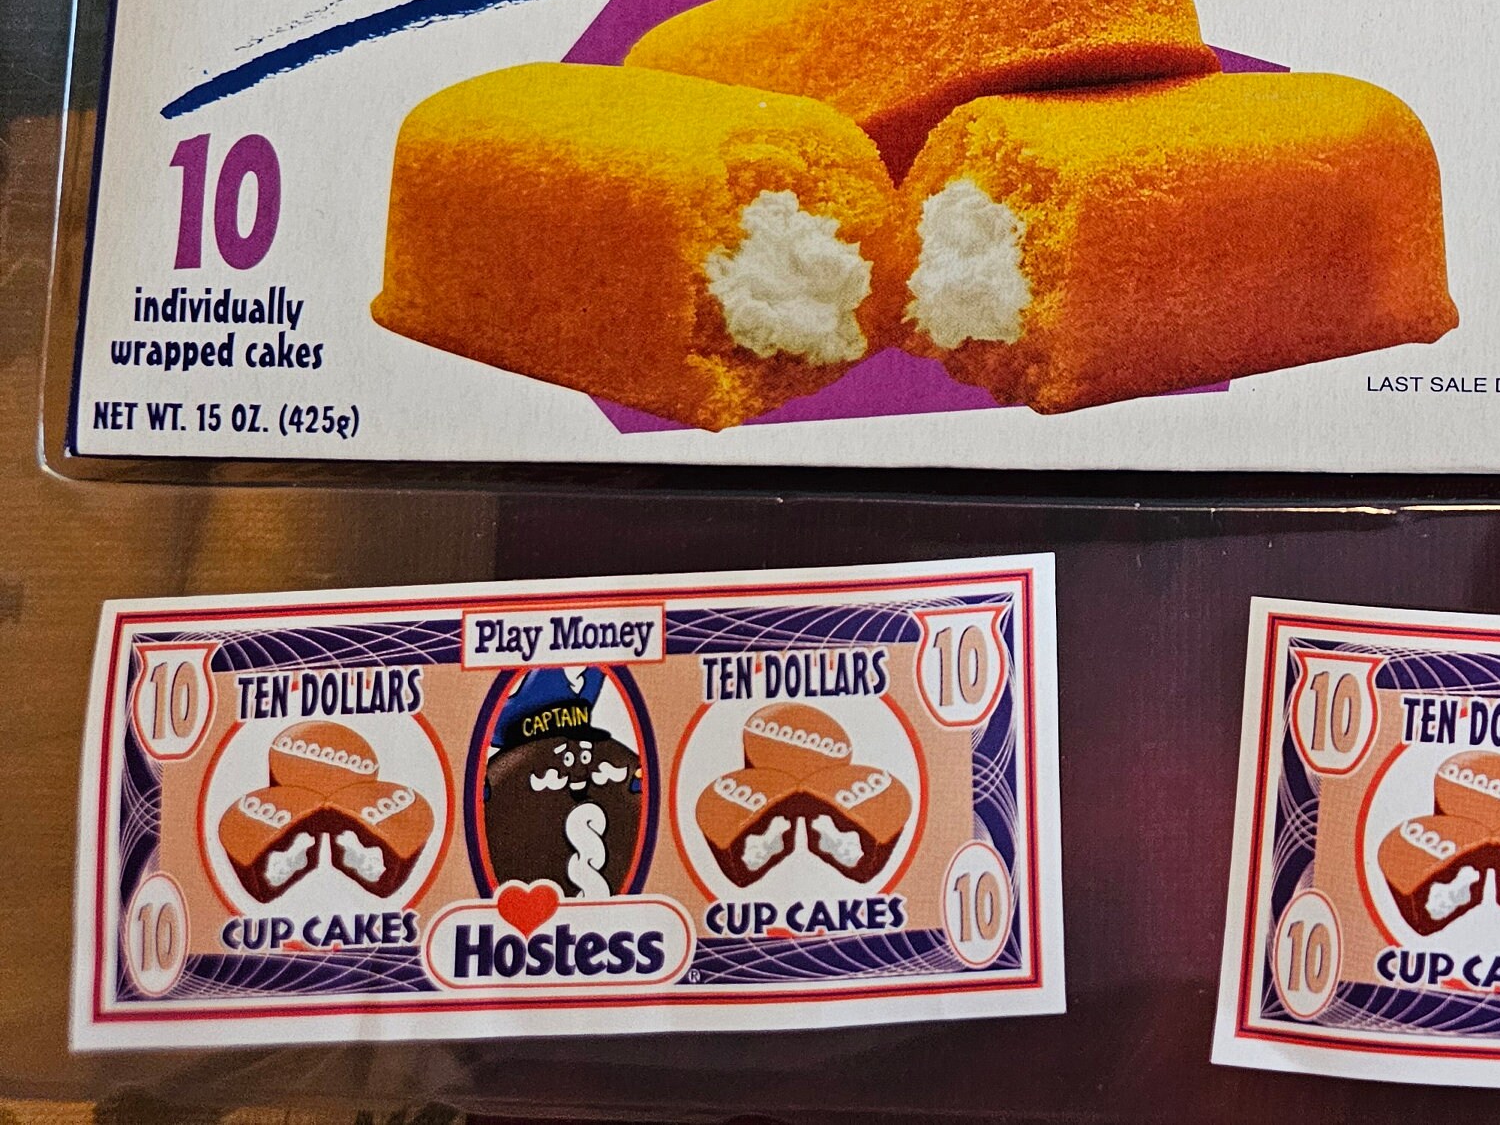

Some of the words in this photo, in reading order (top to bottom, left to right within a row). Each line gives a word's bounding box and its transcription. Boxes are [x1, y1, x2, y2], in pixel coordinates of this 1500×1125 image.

[169, 133, 281, 270] 10
[134, 286, 304, 330] individually
[111, 332, 235, 371] wrapped
[245, 331, 323, 369] cakes
[1367, 376, 1423, 392] LAST
[1430, 377, 1487, 393] SALE
[93, 401, 137, 430] NET
[147, 402, 186, 431] WT.
[196, 403, 221, 432] 15
[231, 404, 268, 433] OZ.
[279, 403, 359, 439] (425g)
[475, 617, 543, 655] Play
[549, 616, 654, 657] Money
[703, 655, 752, 701] TEN
[765, 650, 886, 699] DOLLARS
[933, 625, 987, 707] 10
[149, 661, 191, 739] 10
[238, 675, 289, 720] TEN
[300, 667, 422, 716] DOLLARS
[1310, 671, 1354, 753] 10
[522, 707, 589, 737] CAPTAIN
[1403, 696, 1461, 745] TEN
[222, 917, 294, 951] CUP
[302, 912, 419, 947] CAKES
[706, 898, 777, 934] CUP
[786, 896, 905, 932] CAKES
[955, 871, 995, 942] 10
[136, 902, 179, 972] 10
[454, 924, 665, 978] Hostess
[1286, 918, 1330, 992] 10
[1377, 950, 1454, 985] CUP
